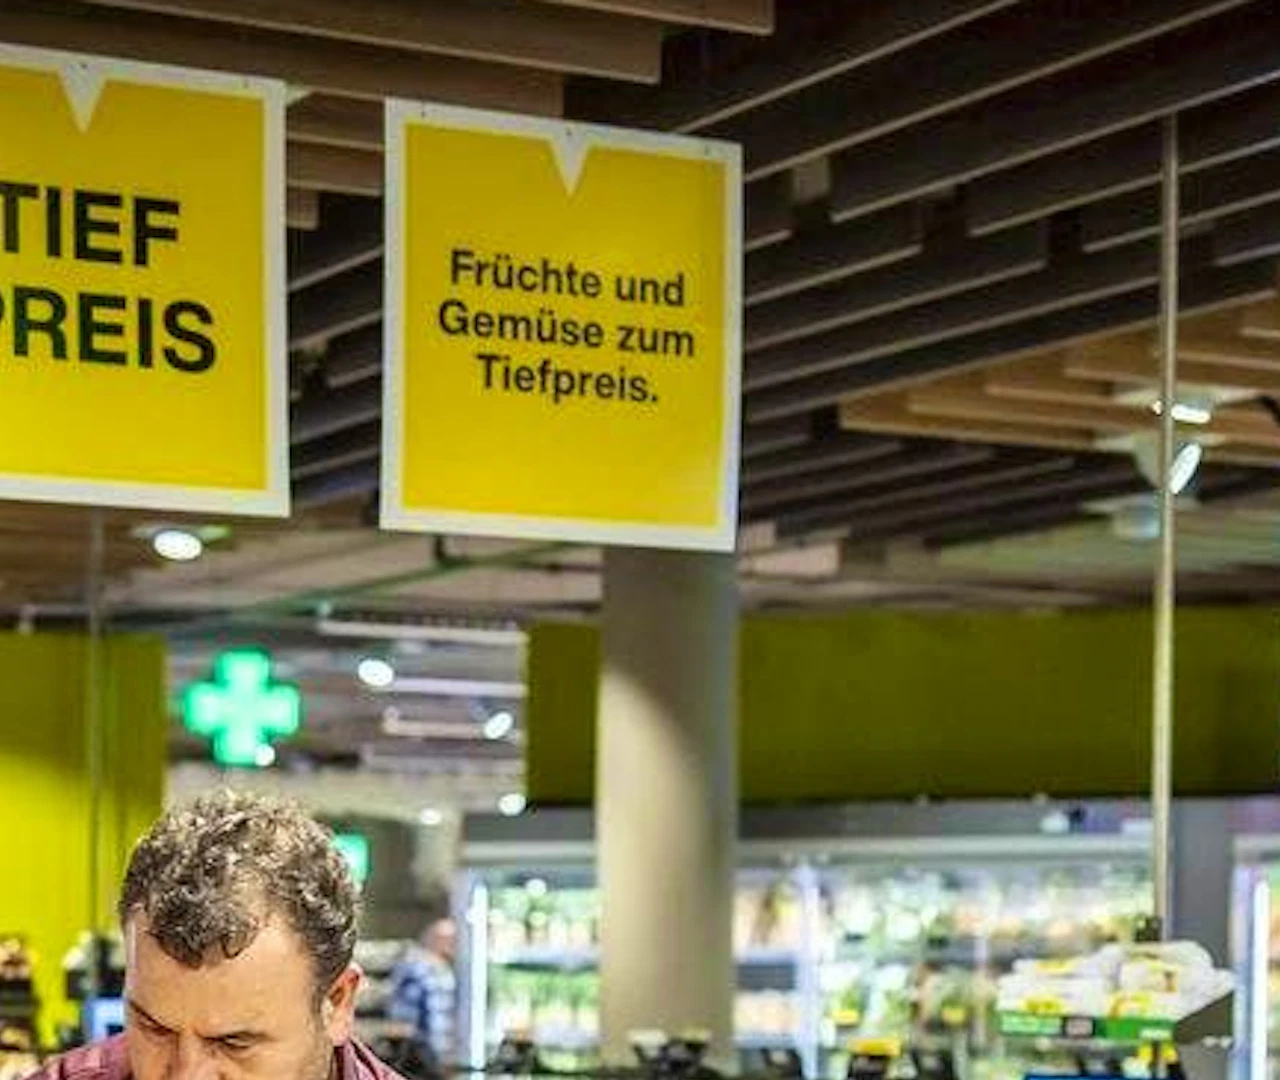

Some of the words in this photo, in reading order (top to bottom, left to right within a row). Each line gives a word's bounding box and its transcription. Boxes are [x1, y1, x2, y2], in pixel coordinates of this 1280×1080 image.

[449, 247, 603, 300] Früchte
[614, 272, 686, 308] und
[437, 297, 605, 350] Gemüse
[616, 324, 695, 358] zum
[474, 351, 659, 405] Tiefpreis.
